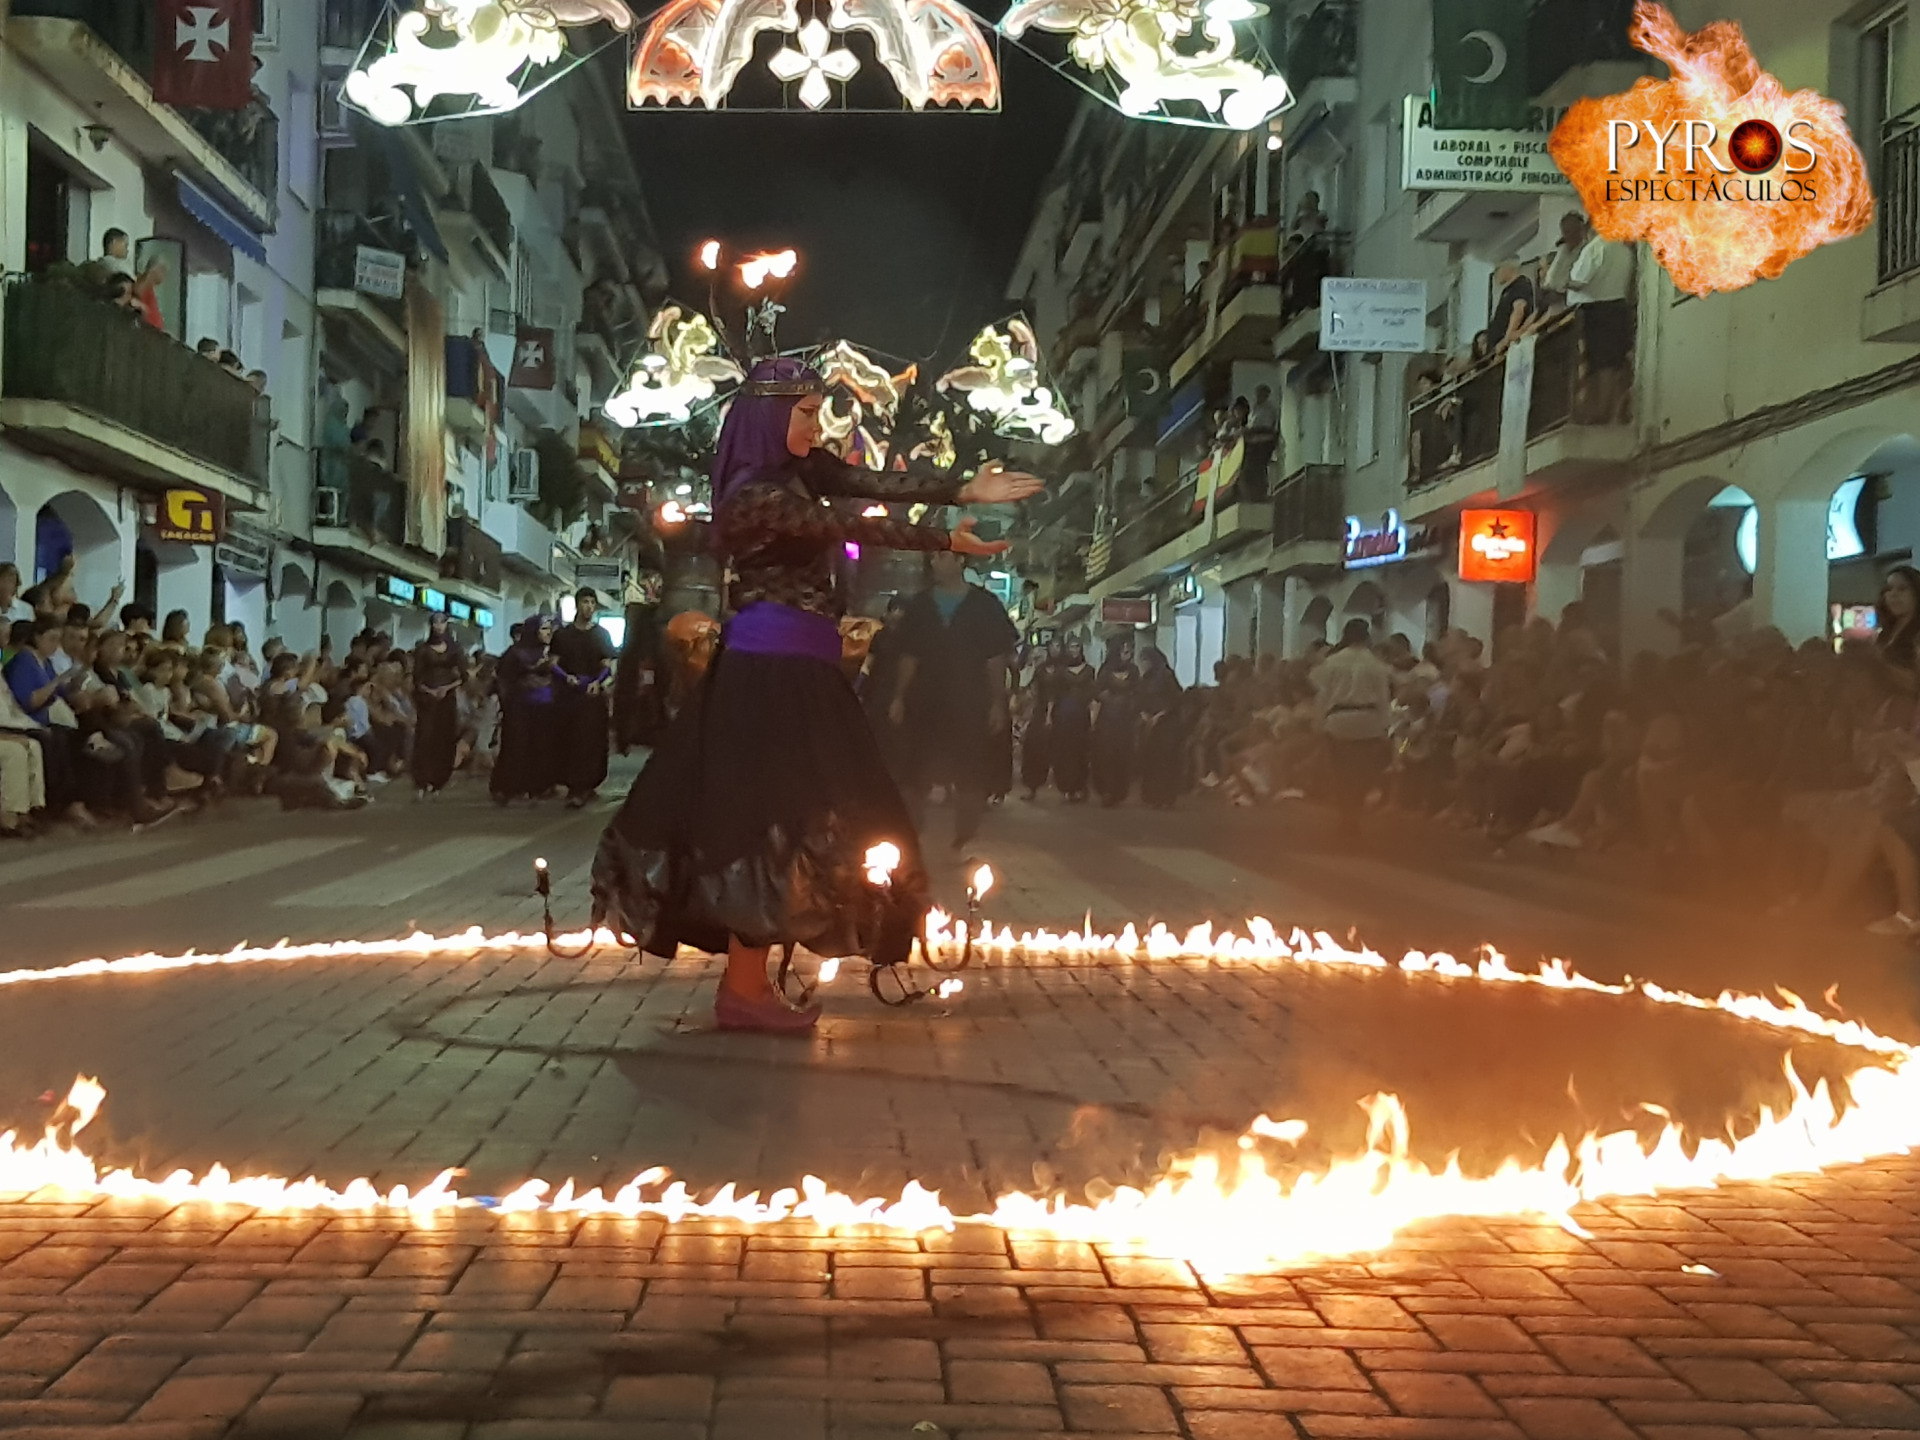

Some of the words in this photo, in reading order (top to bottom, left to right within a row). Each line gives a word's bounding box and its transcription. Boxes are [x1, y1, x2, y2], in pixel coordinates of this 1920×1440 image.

[1433, 139, 1491, 152] LABORAL
[1513, 141, 1548, 153] FISCA
[1457, 155, 1530, 168] COMPTABLE
[1415, 168, 1513, 183] ADMINISTRACIÓ
